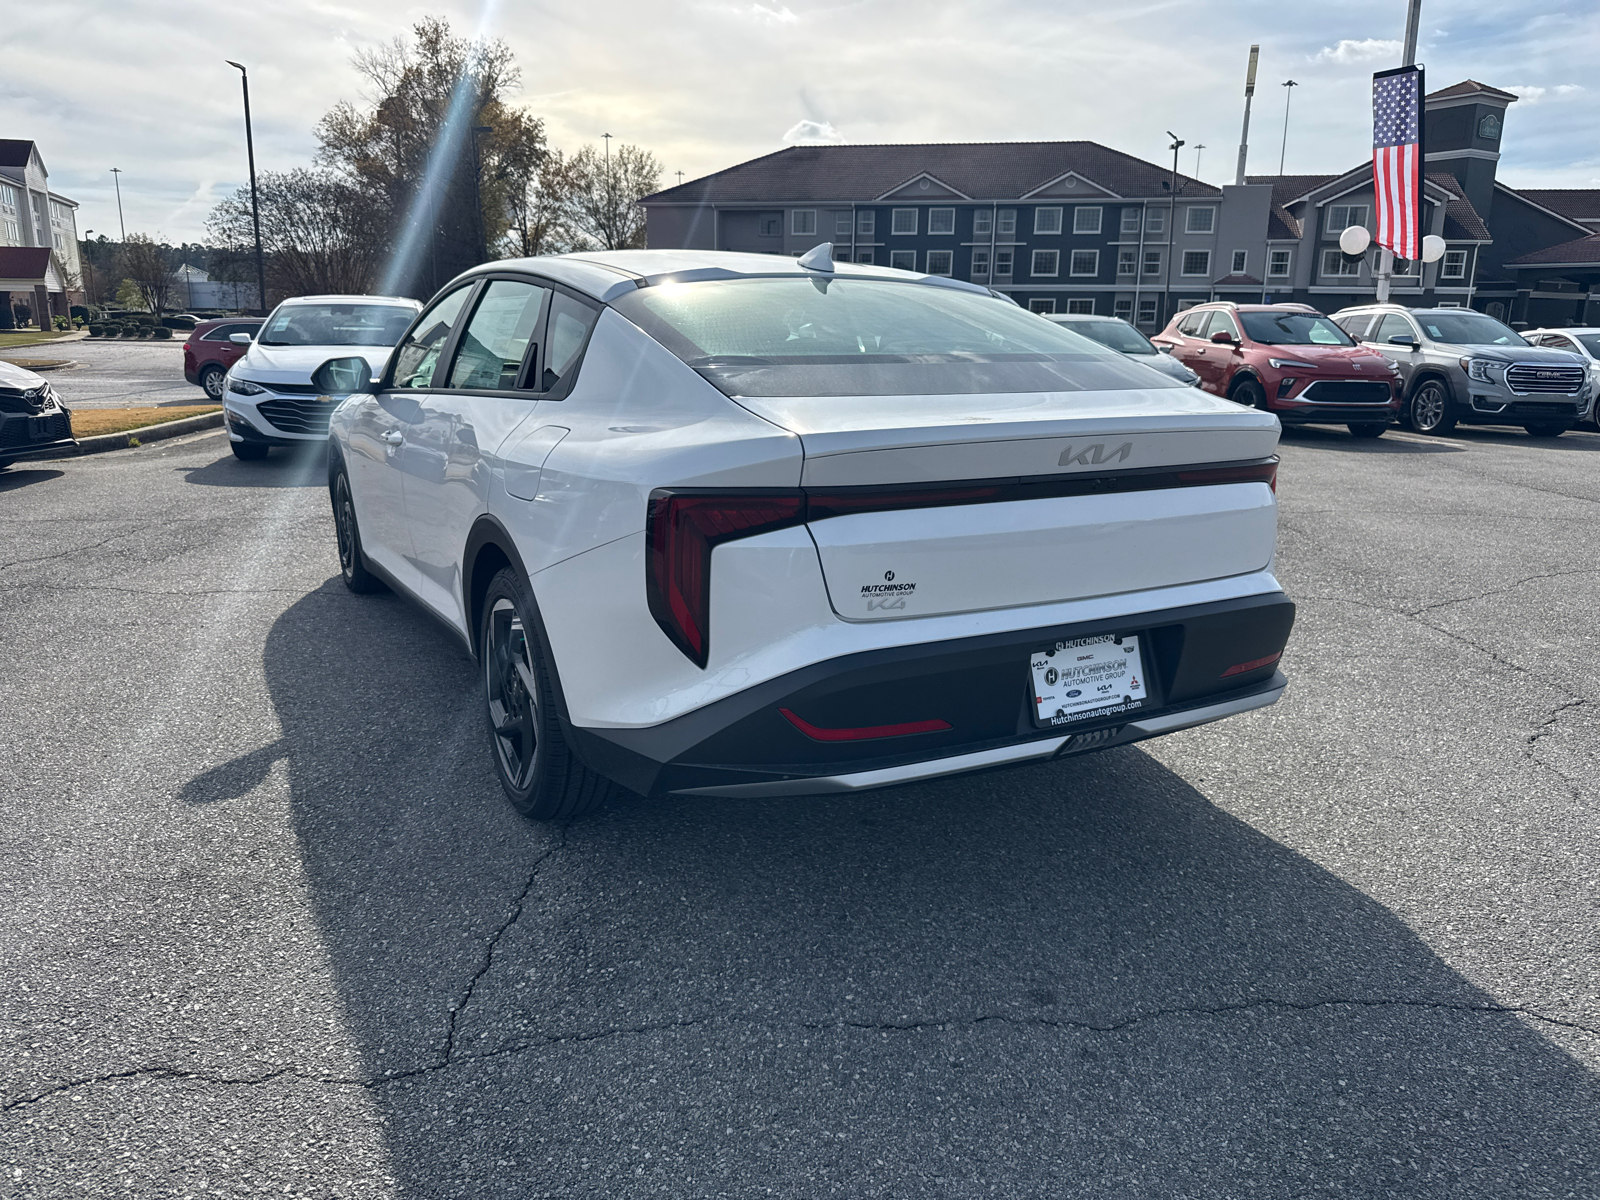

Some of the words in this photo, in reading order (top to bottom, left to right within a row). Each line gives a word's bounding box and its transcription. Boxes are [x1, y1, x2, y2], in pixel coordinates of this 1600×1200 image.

[1058, 442, 1133, 467] KIA
[860, 582, 917, 593] HUTCHINSON
[867, 597, 906, 612] K4
[1065, 633, 1116, 650] HUTCHINSON
[1032, 660, 1049, 668] KIA
[1076, 654, 1094, 662] GMC
[1060, 658, 1127, 681] HUTCHINSON
[1062, 673, 1104, 688] AUTOMOTIVE
[1104, 670, 1126, 681] GROUP
[1096, 683, 1113, 692] KIA
[1061, 693, 1121, 709] HUTCHINSONAUTOGROUP.COM
[1050, 700, 1142, 726] Hutchinsonautogroup.com
